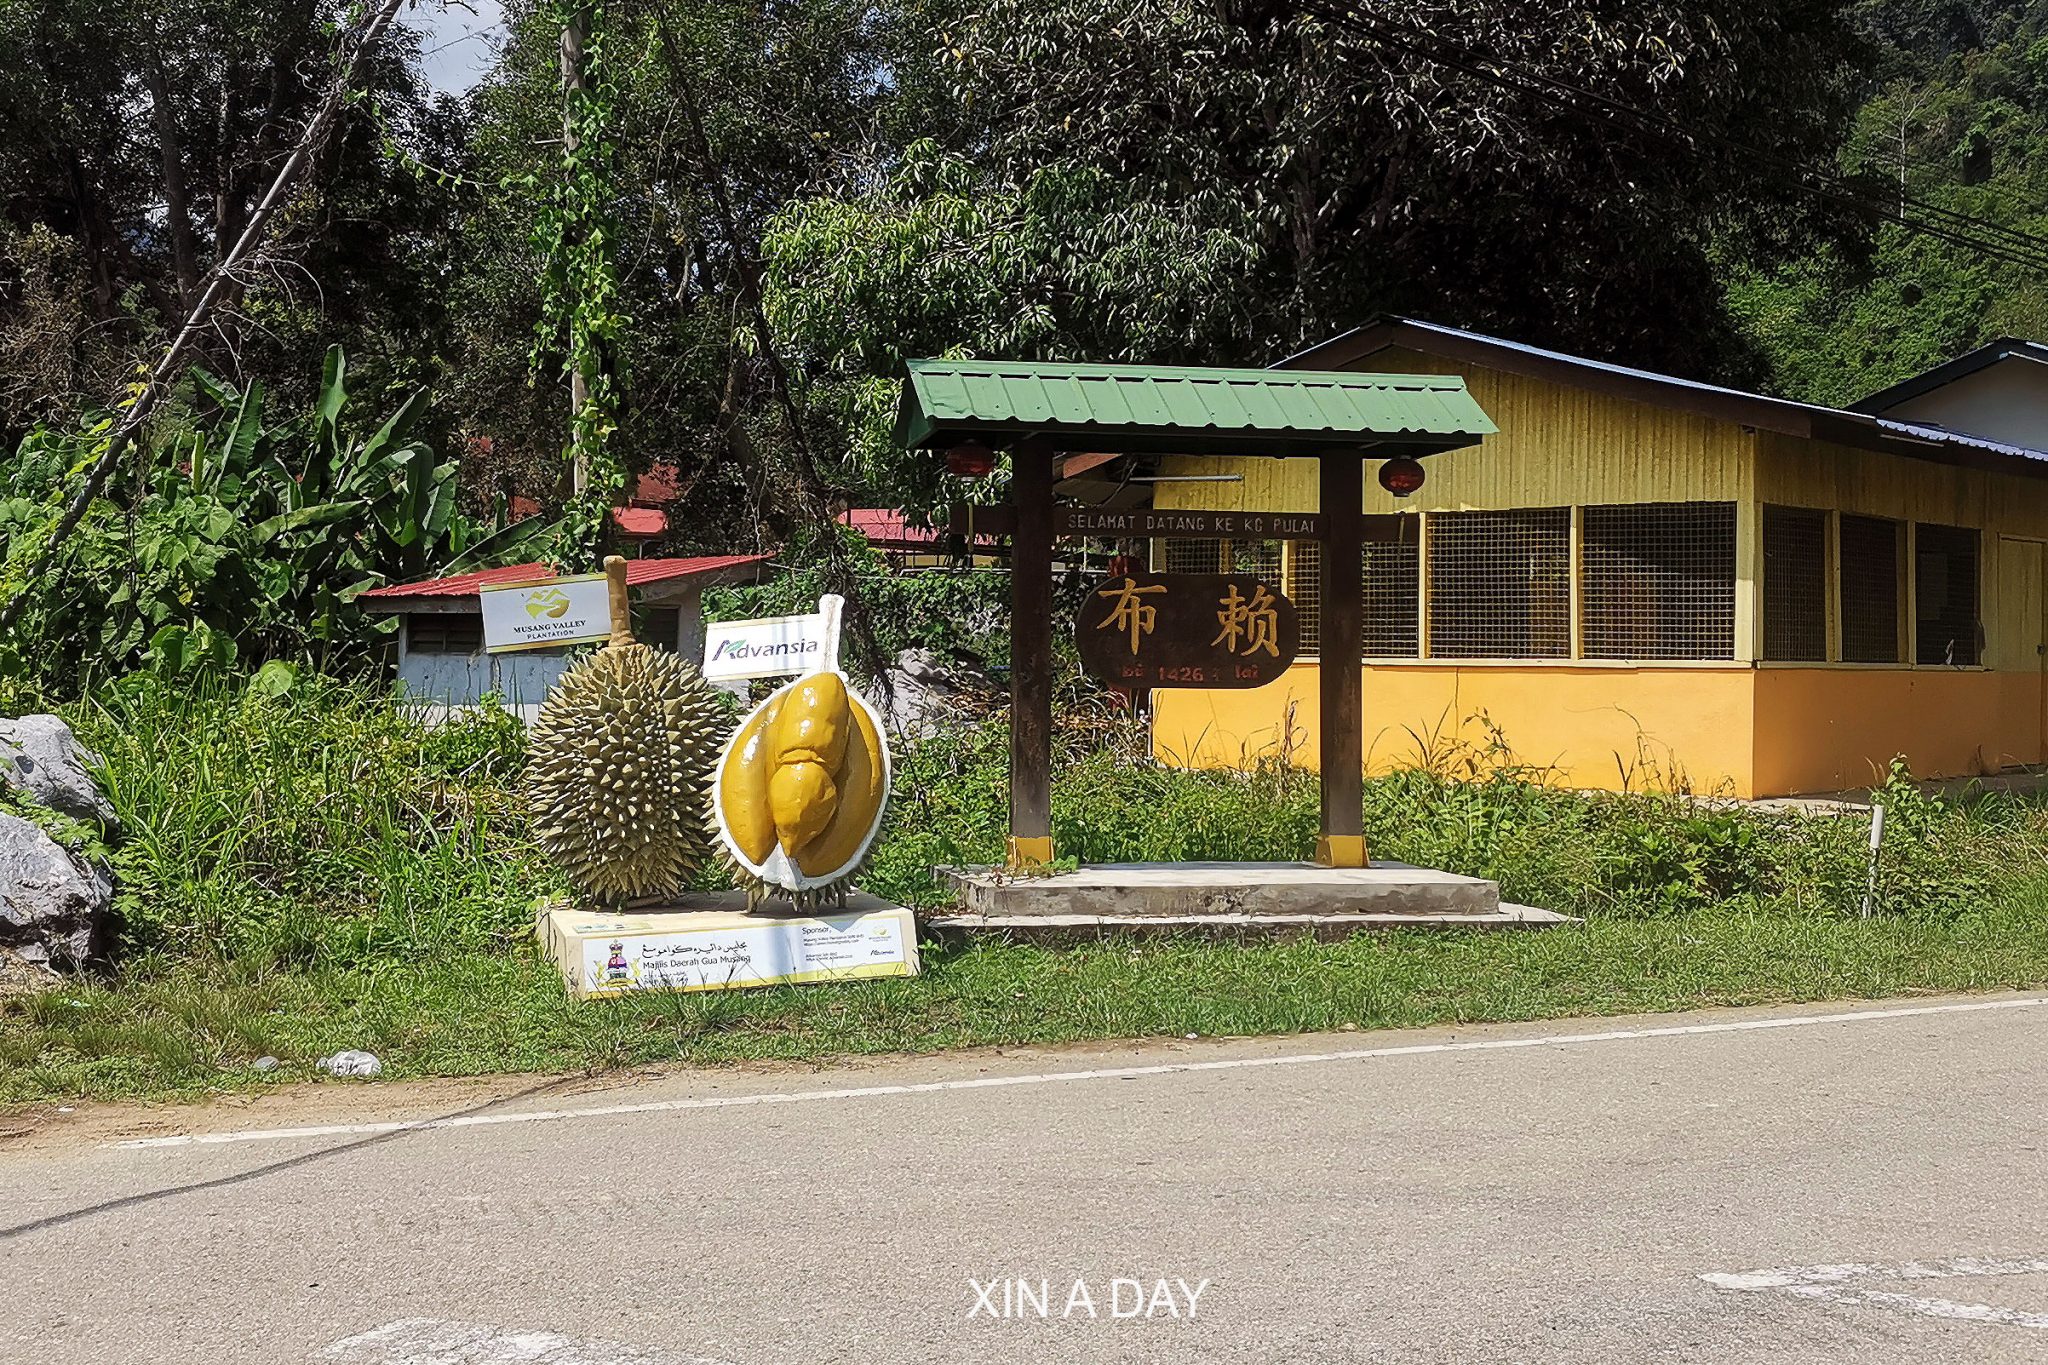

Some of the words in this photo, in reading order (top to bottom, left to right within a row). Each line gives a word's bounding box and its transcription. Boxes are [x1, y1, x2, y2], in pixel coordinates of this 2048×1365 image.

[1068, 514, 1135, 530] SELAMAT
[1146, 515, 1204, 531] DATANG
[1215, 517, 1233, 532] KE
[1273, 518, 1314, 534] PULAI
[514, 624, 551, 633] MUSANG
[553, 620, 586, 629] VALLEY
[527, 630, 574, 639] PLANTATION
[711, 638, 818, 662] Advansia
[670, 958, 699, 968] Daerah
